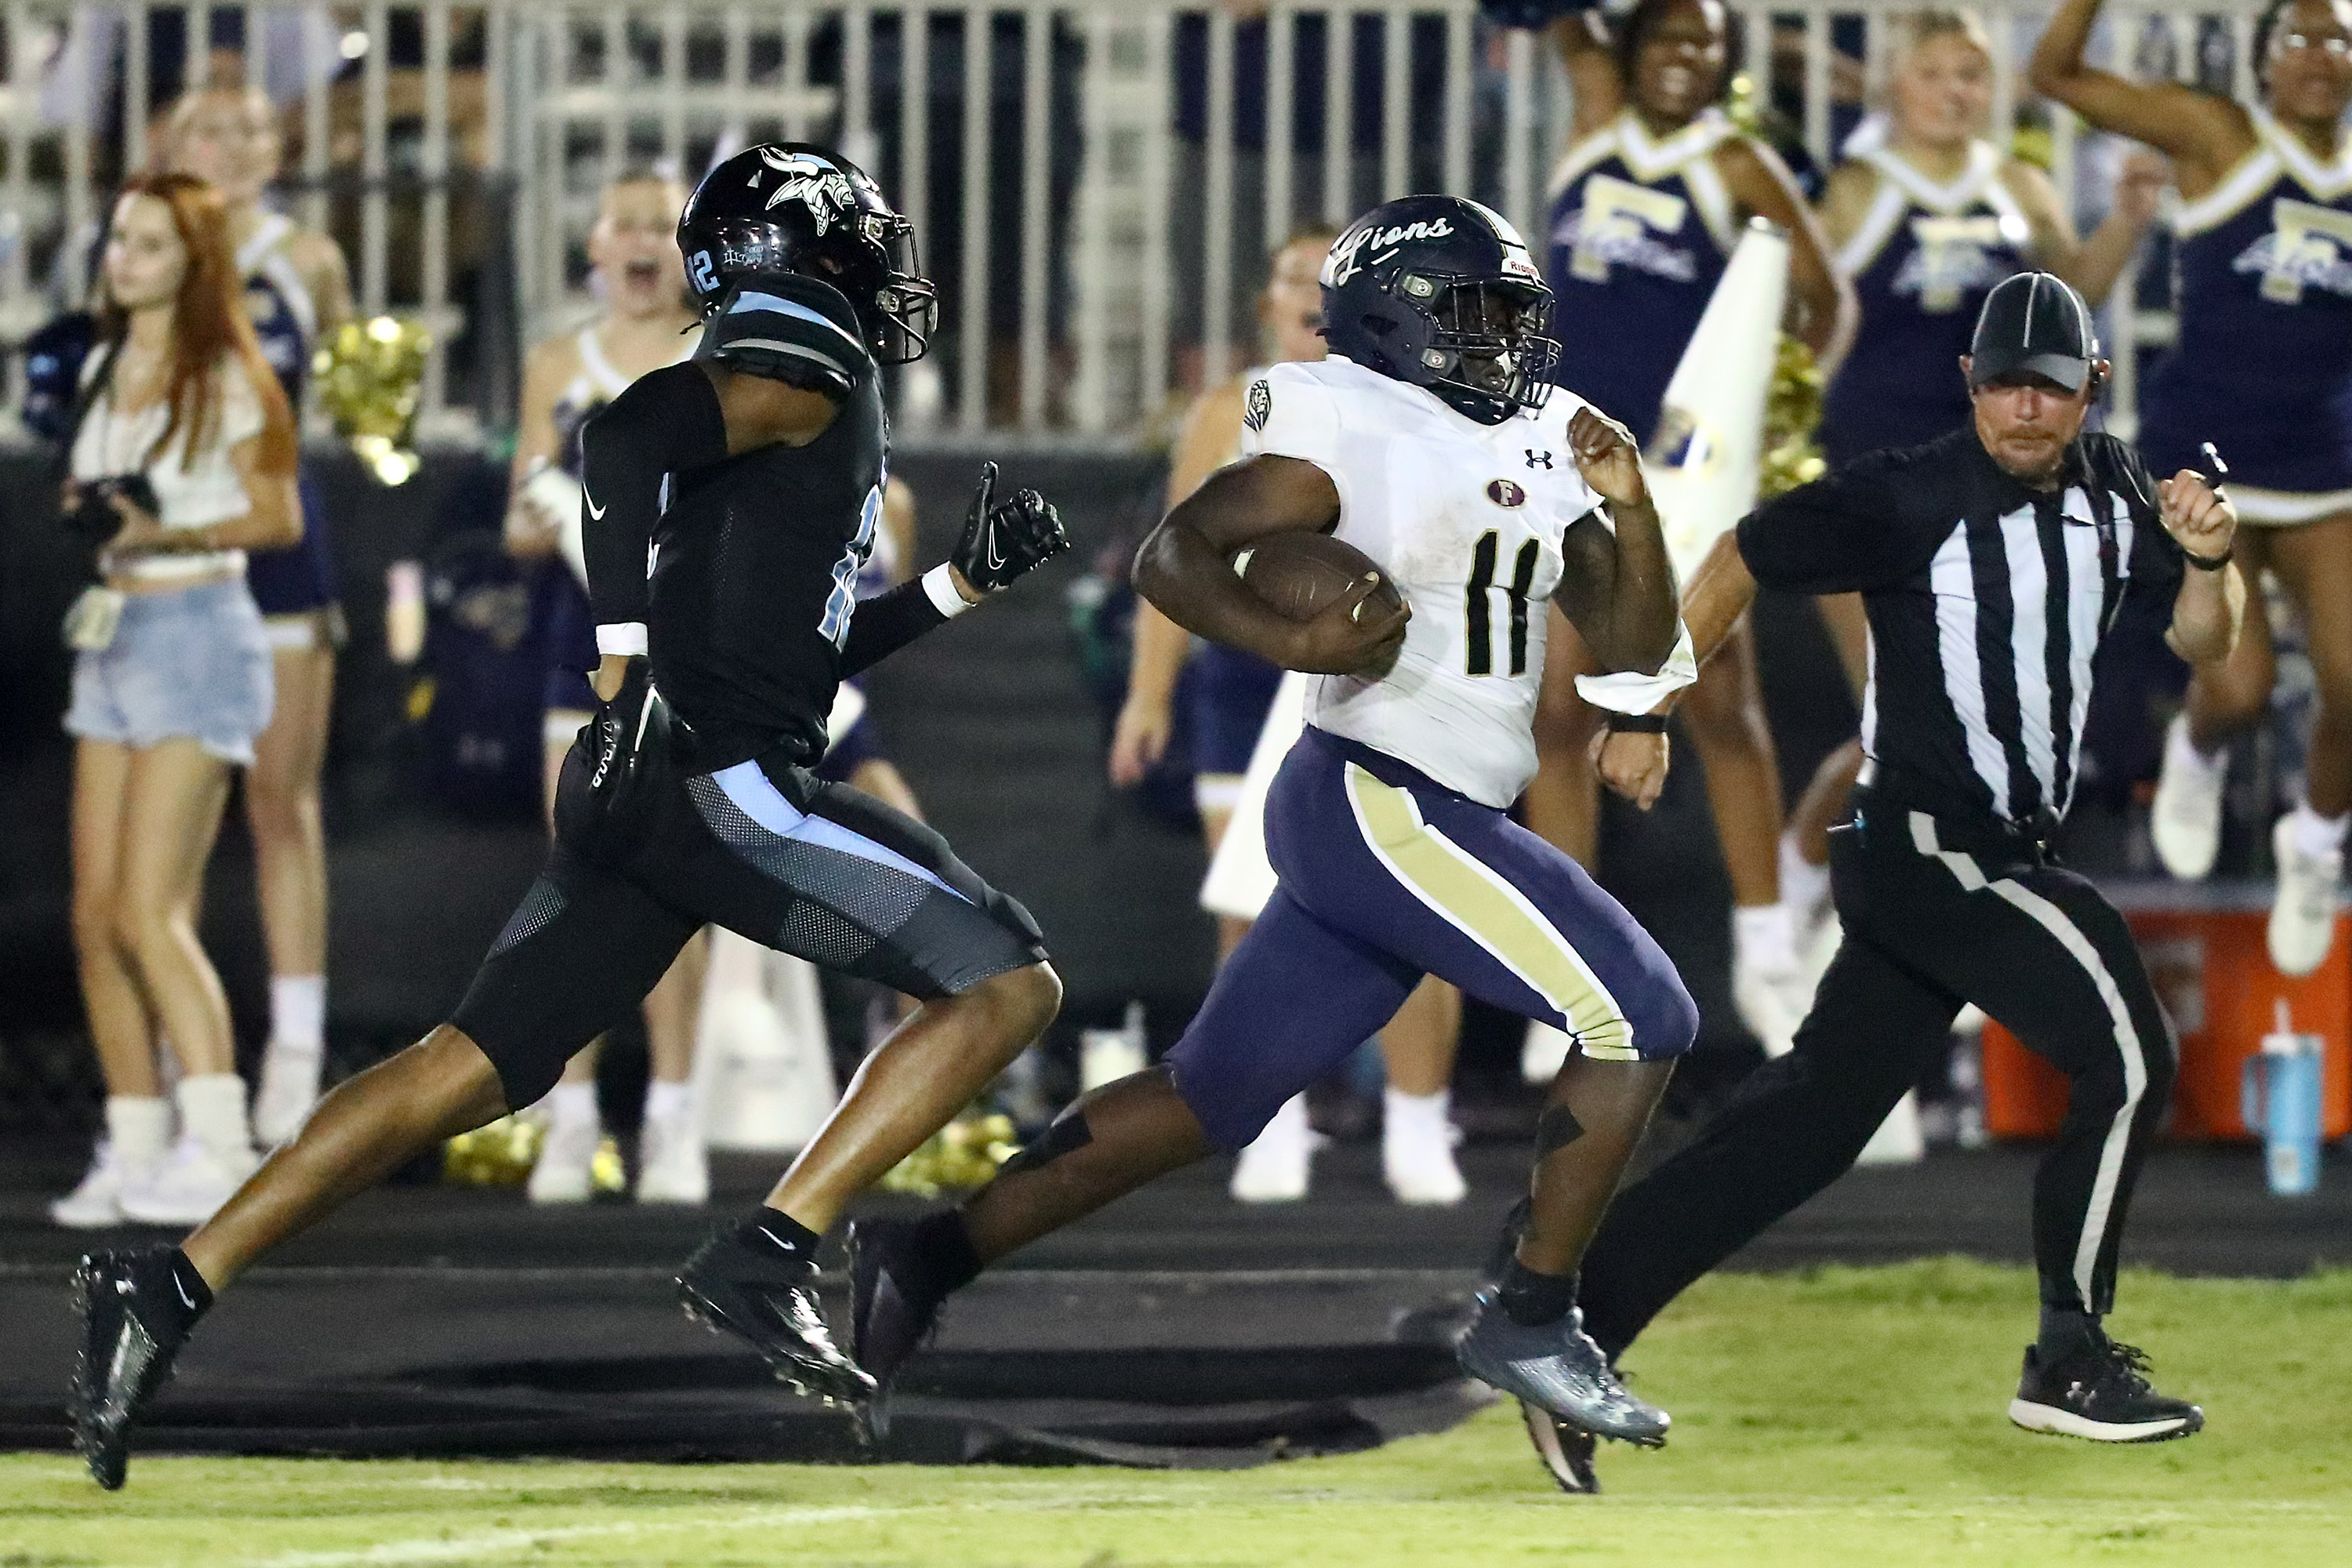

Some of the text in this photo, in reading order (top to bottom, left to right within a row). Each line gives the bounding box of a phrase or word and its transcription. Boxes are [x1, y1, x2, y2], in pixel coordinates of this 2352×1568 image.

[1330, 217, 1454, 287] Lions
[1497, 480, 1514, 506] F
[1463, 528, 1540, 677] 11
